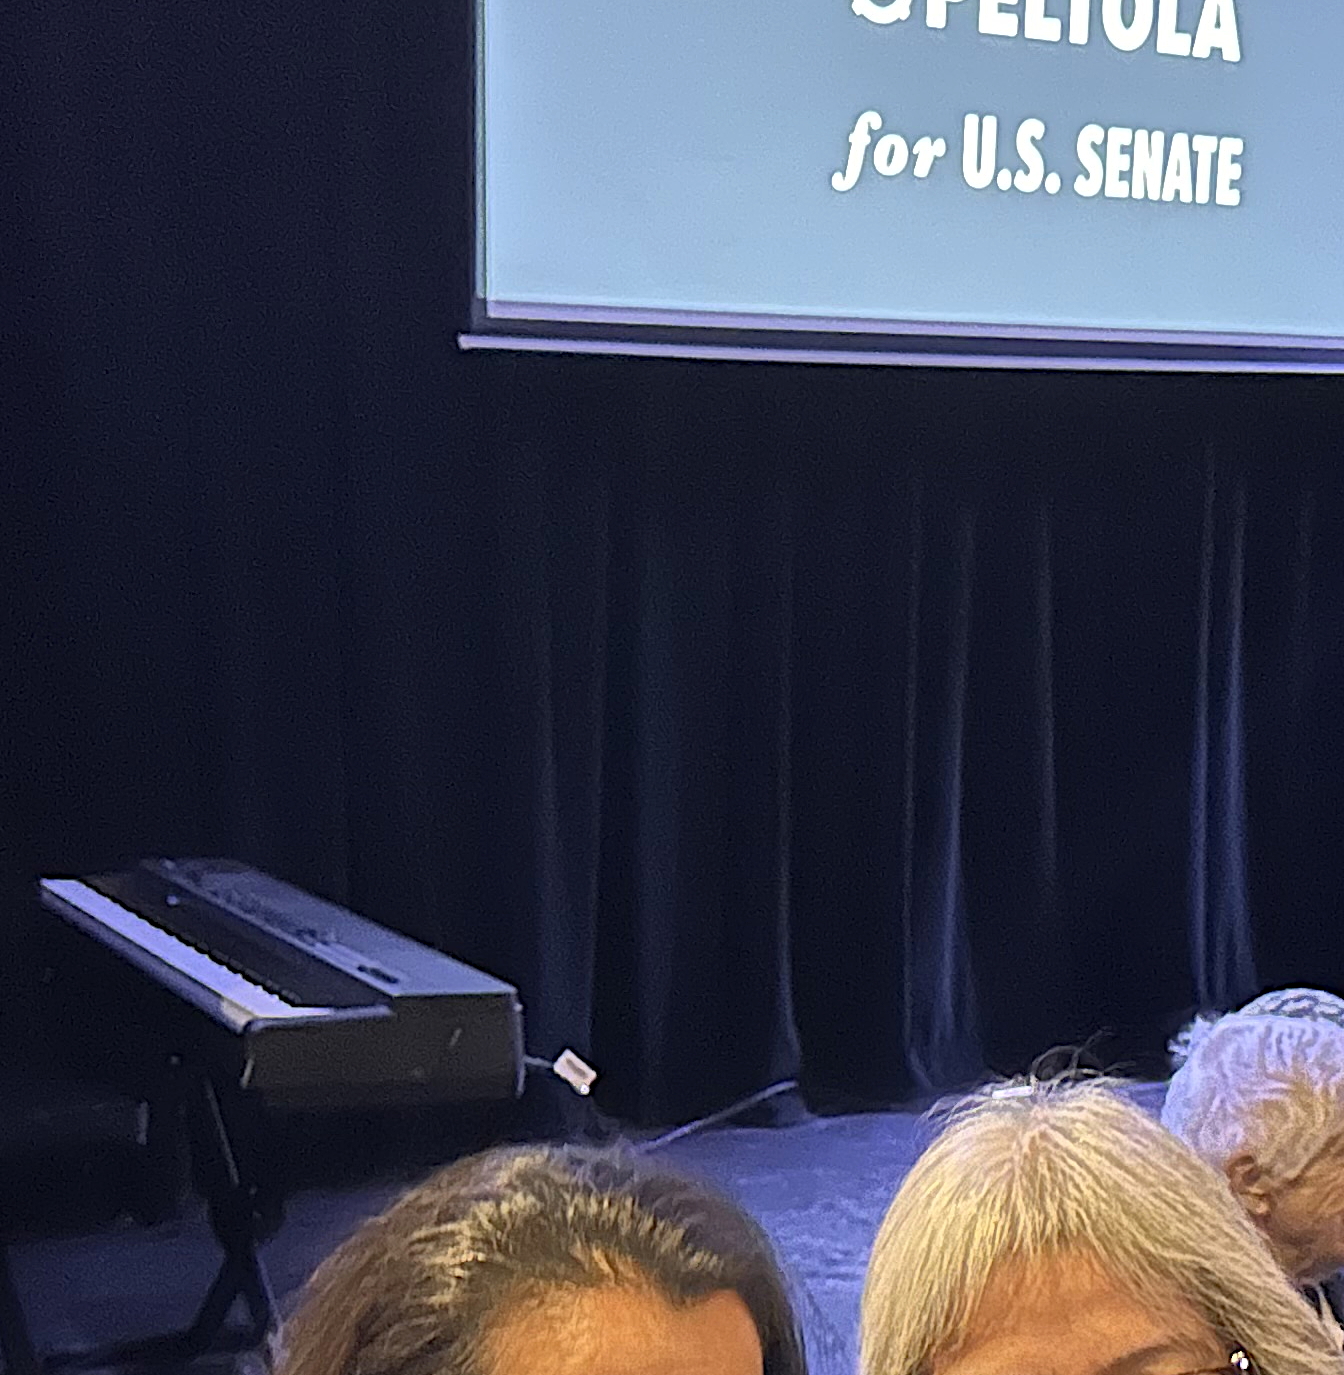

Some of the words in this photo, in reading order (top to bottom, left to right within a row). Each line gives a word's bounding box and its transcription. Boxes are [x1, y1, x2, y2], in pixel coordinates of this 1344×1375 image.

[831, 110, 947, 192] for
[962, 113, 1061, 194] U.S.
[1073, 123, 1244, 206] SENATE
